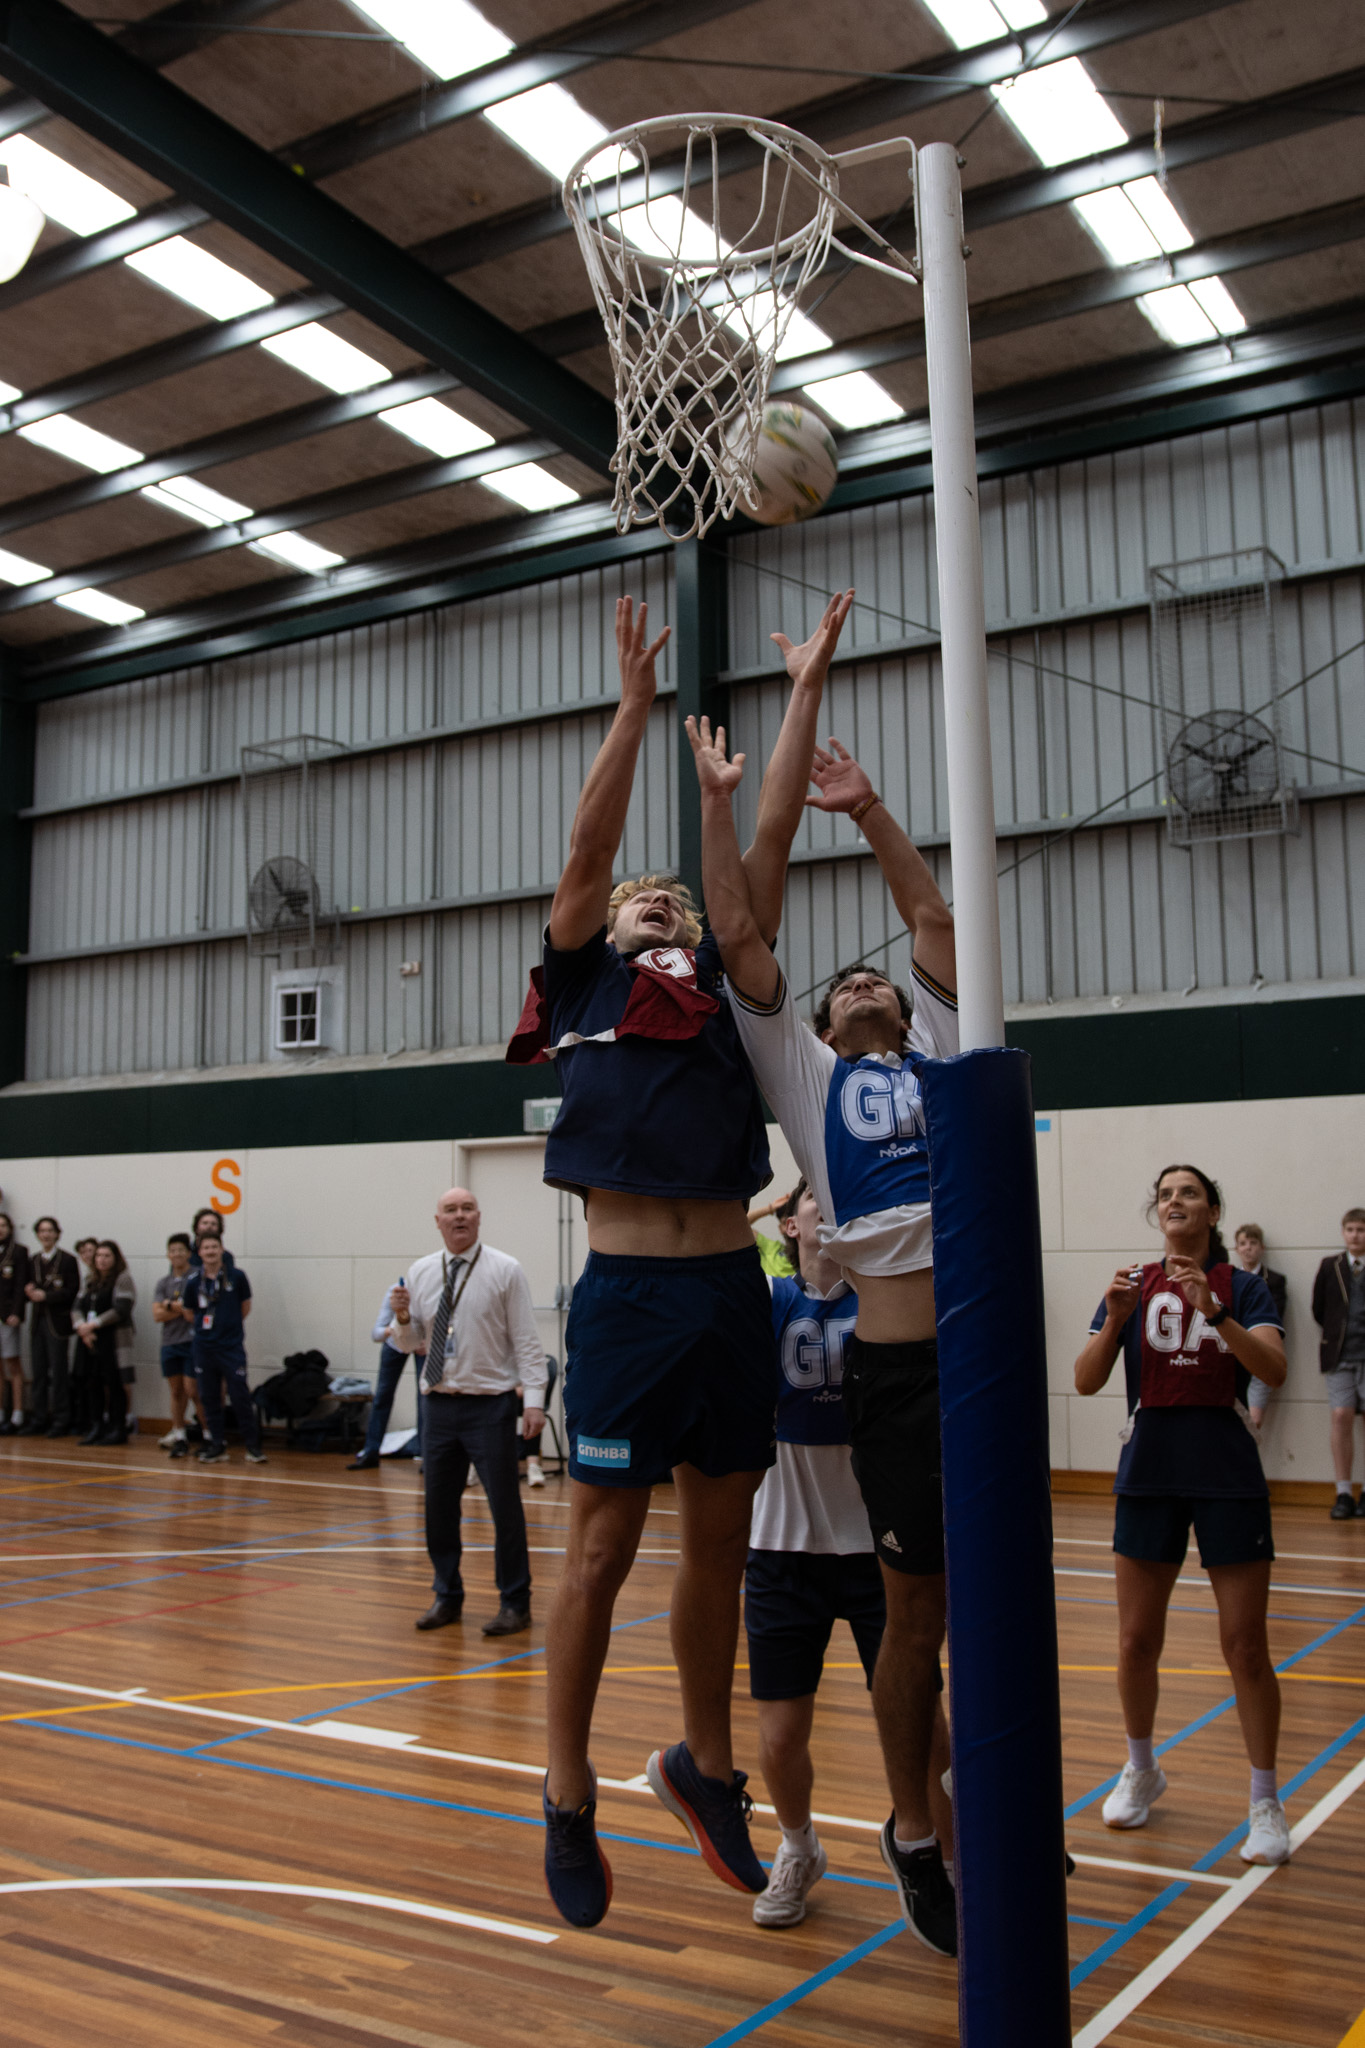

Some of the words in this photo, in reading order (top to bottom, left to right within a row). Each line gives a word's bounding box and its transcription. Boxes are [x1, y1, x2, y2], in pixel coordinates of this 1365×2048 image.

[879, 1144, 918, 1158] NYDA
[210, 1158, 242, 1215] S
[1145, 1291, 1234, 1353] GA
